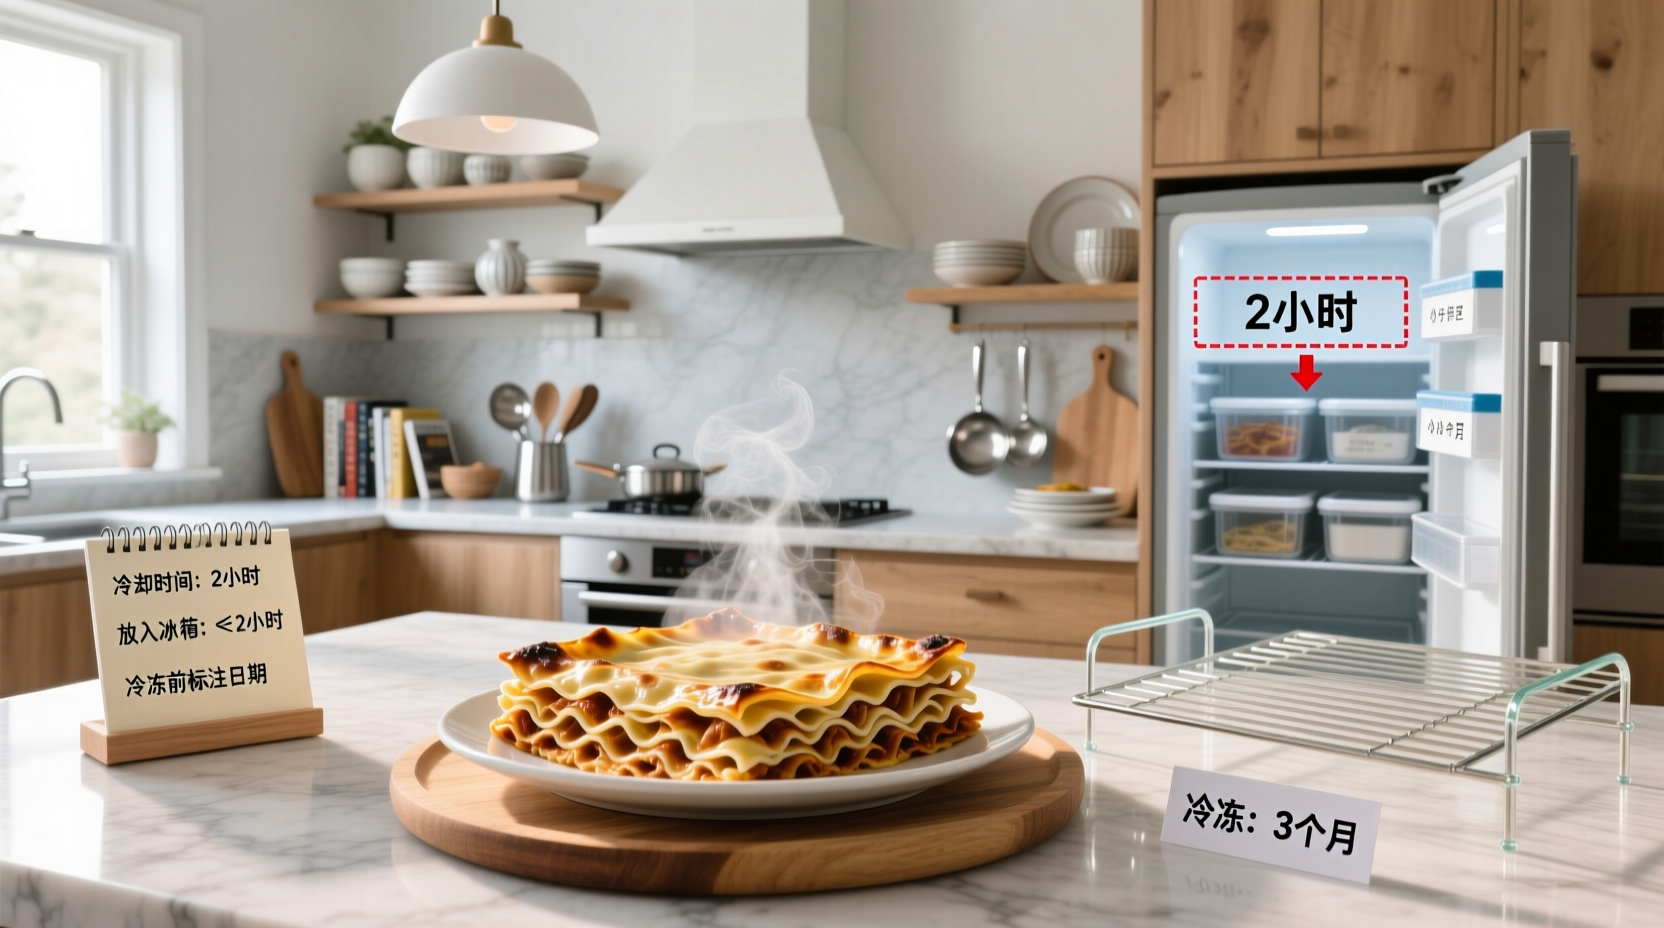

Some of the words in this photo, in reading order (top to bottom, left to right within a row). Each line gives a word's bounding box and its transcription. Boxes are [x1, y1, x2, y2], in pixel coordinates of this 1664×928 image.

[125, 662, 268, 698] 冷冻前标注日期
